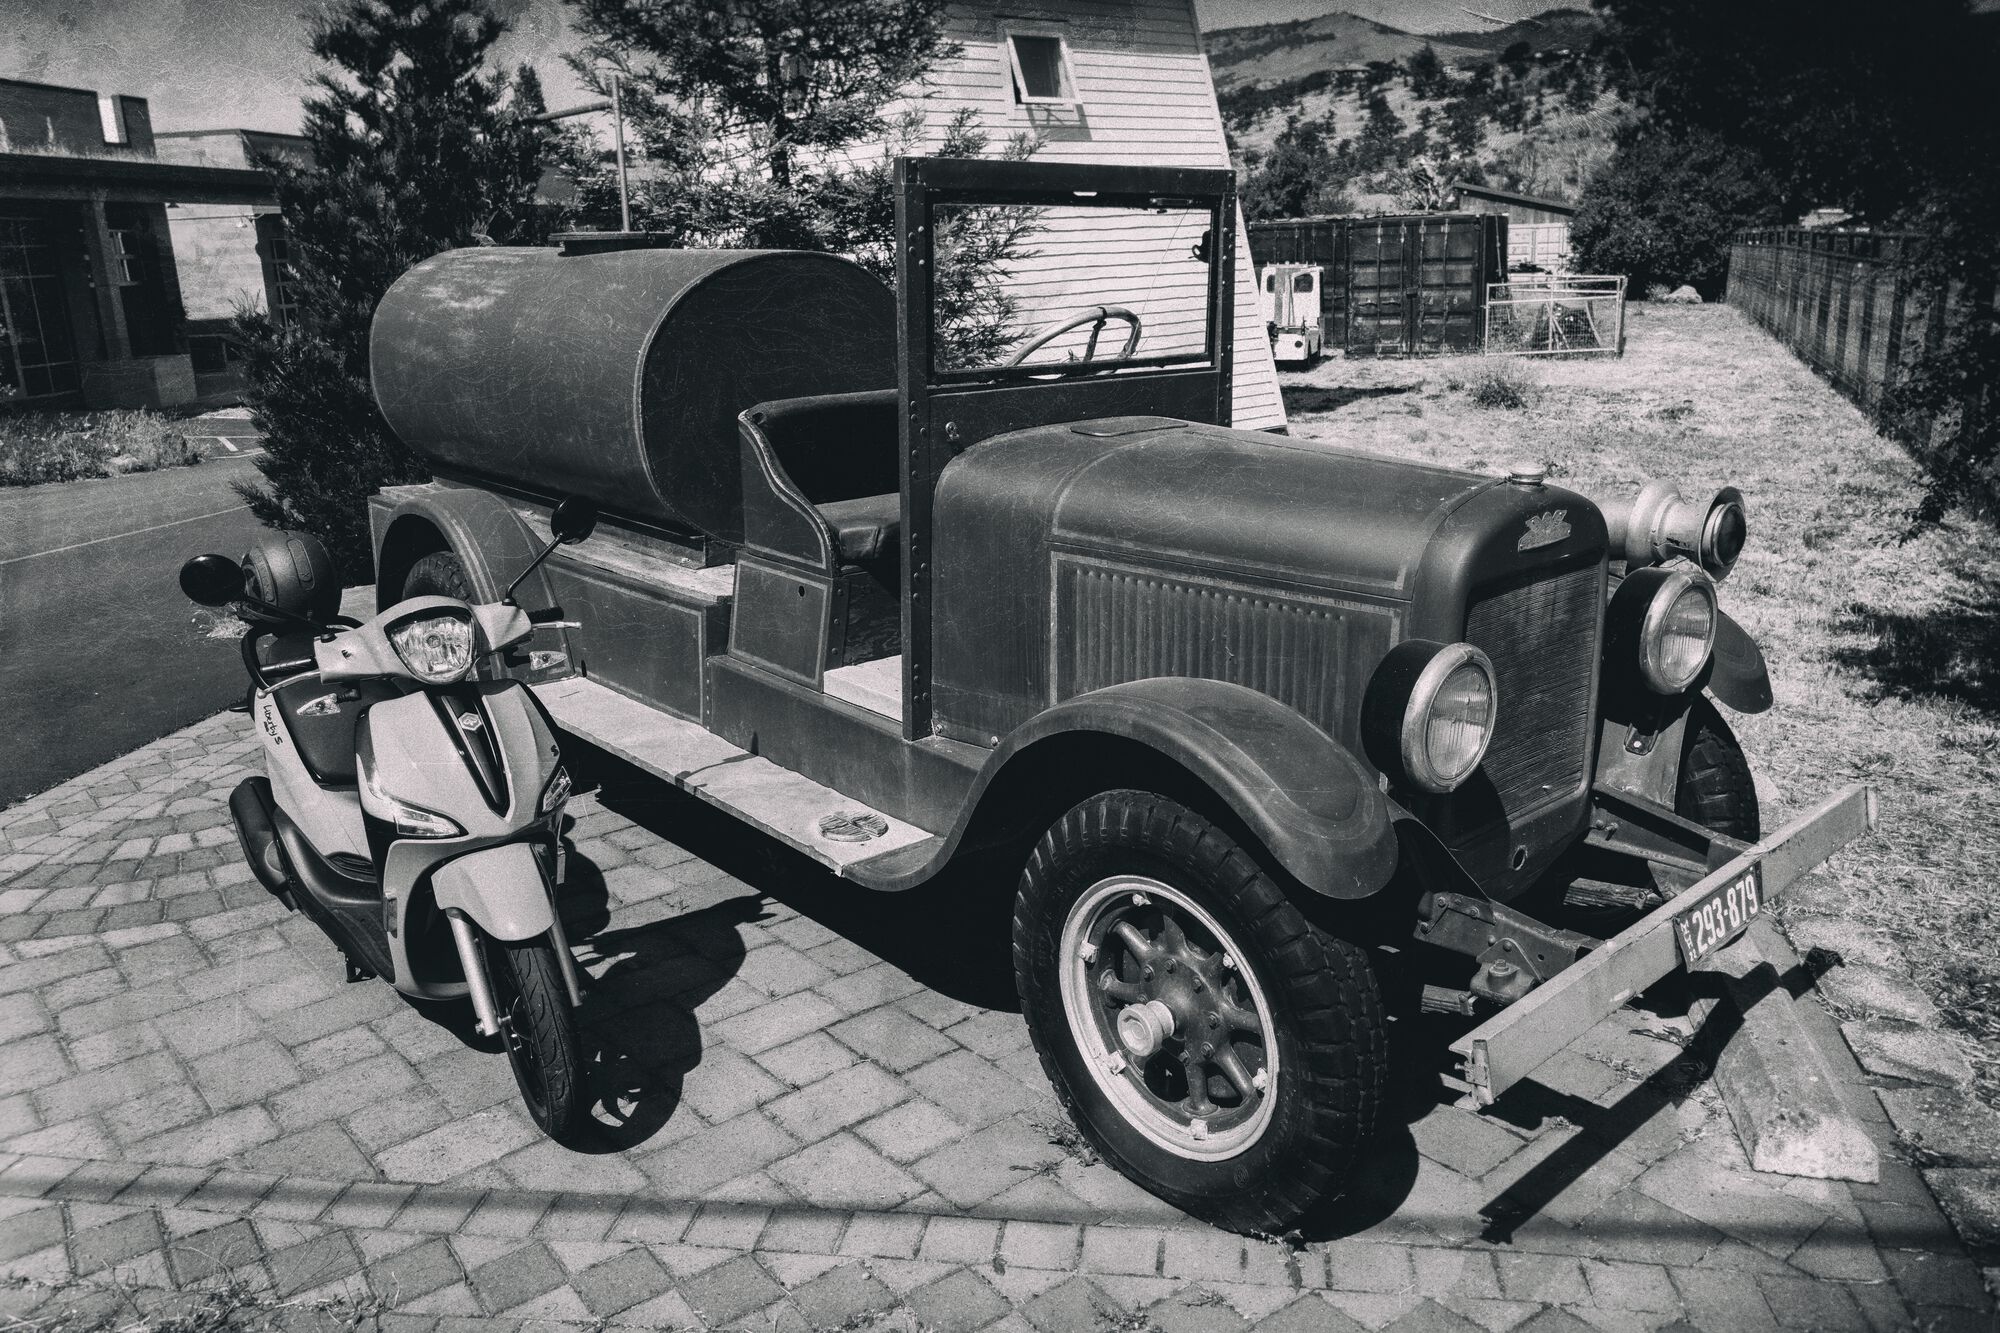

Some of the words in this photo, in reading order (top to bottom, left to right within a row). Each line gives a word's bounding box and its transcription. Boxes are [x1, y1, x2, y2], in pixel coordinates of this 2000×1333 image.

[263, 705, 278, 737] Liberty
[274, 736, 283, 745] S
[1692, 874, 1758, 954] 293-879
